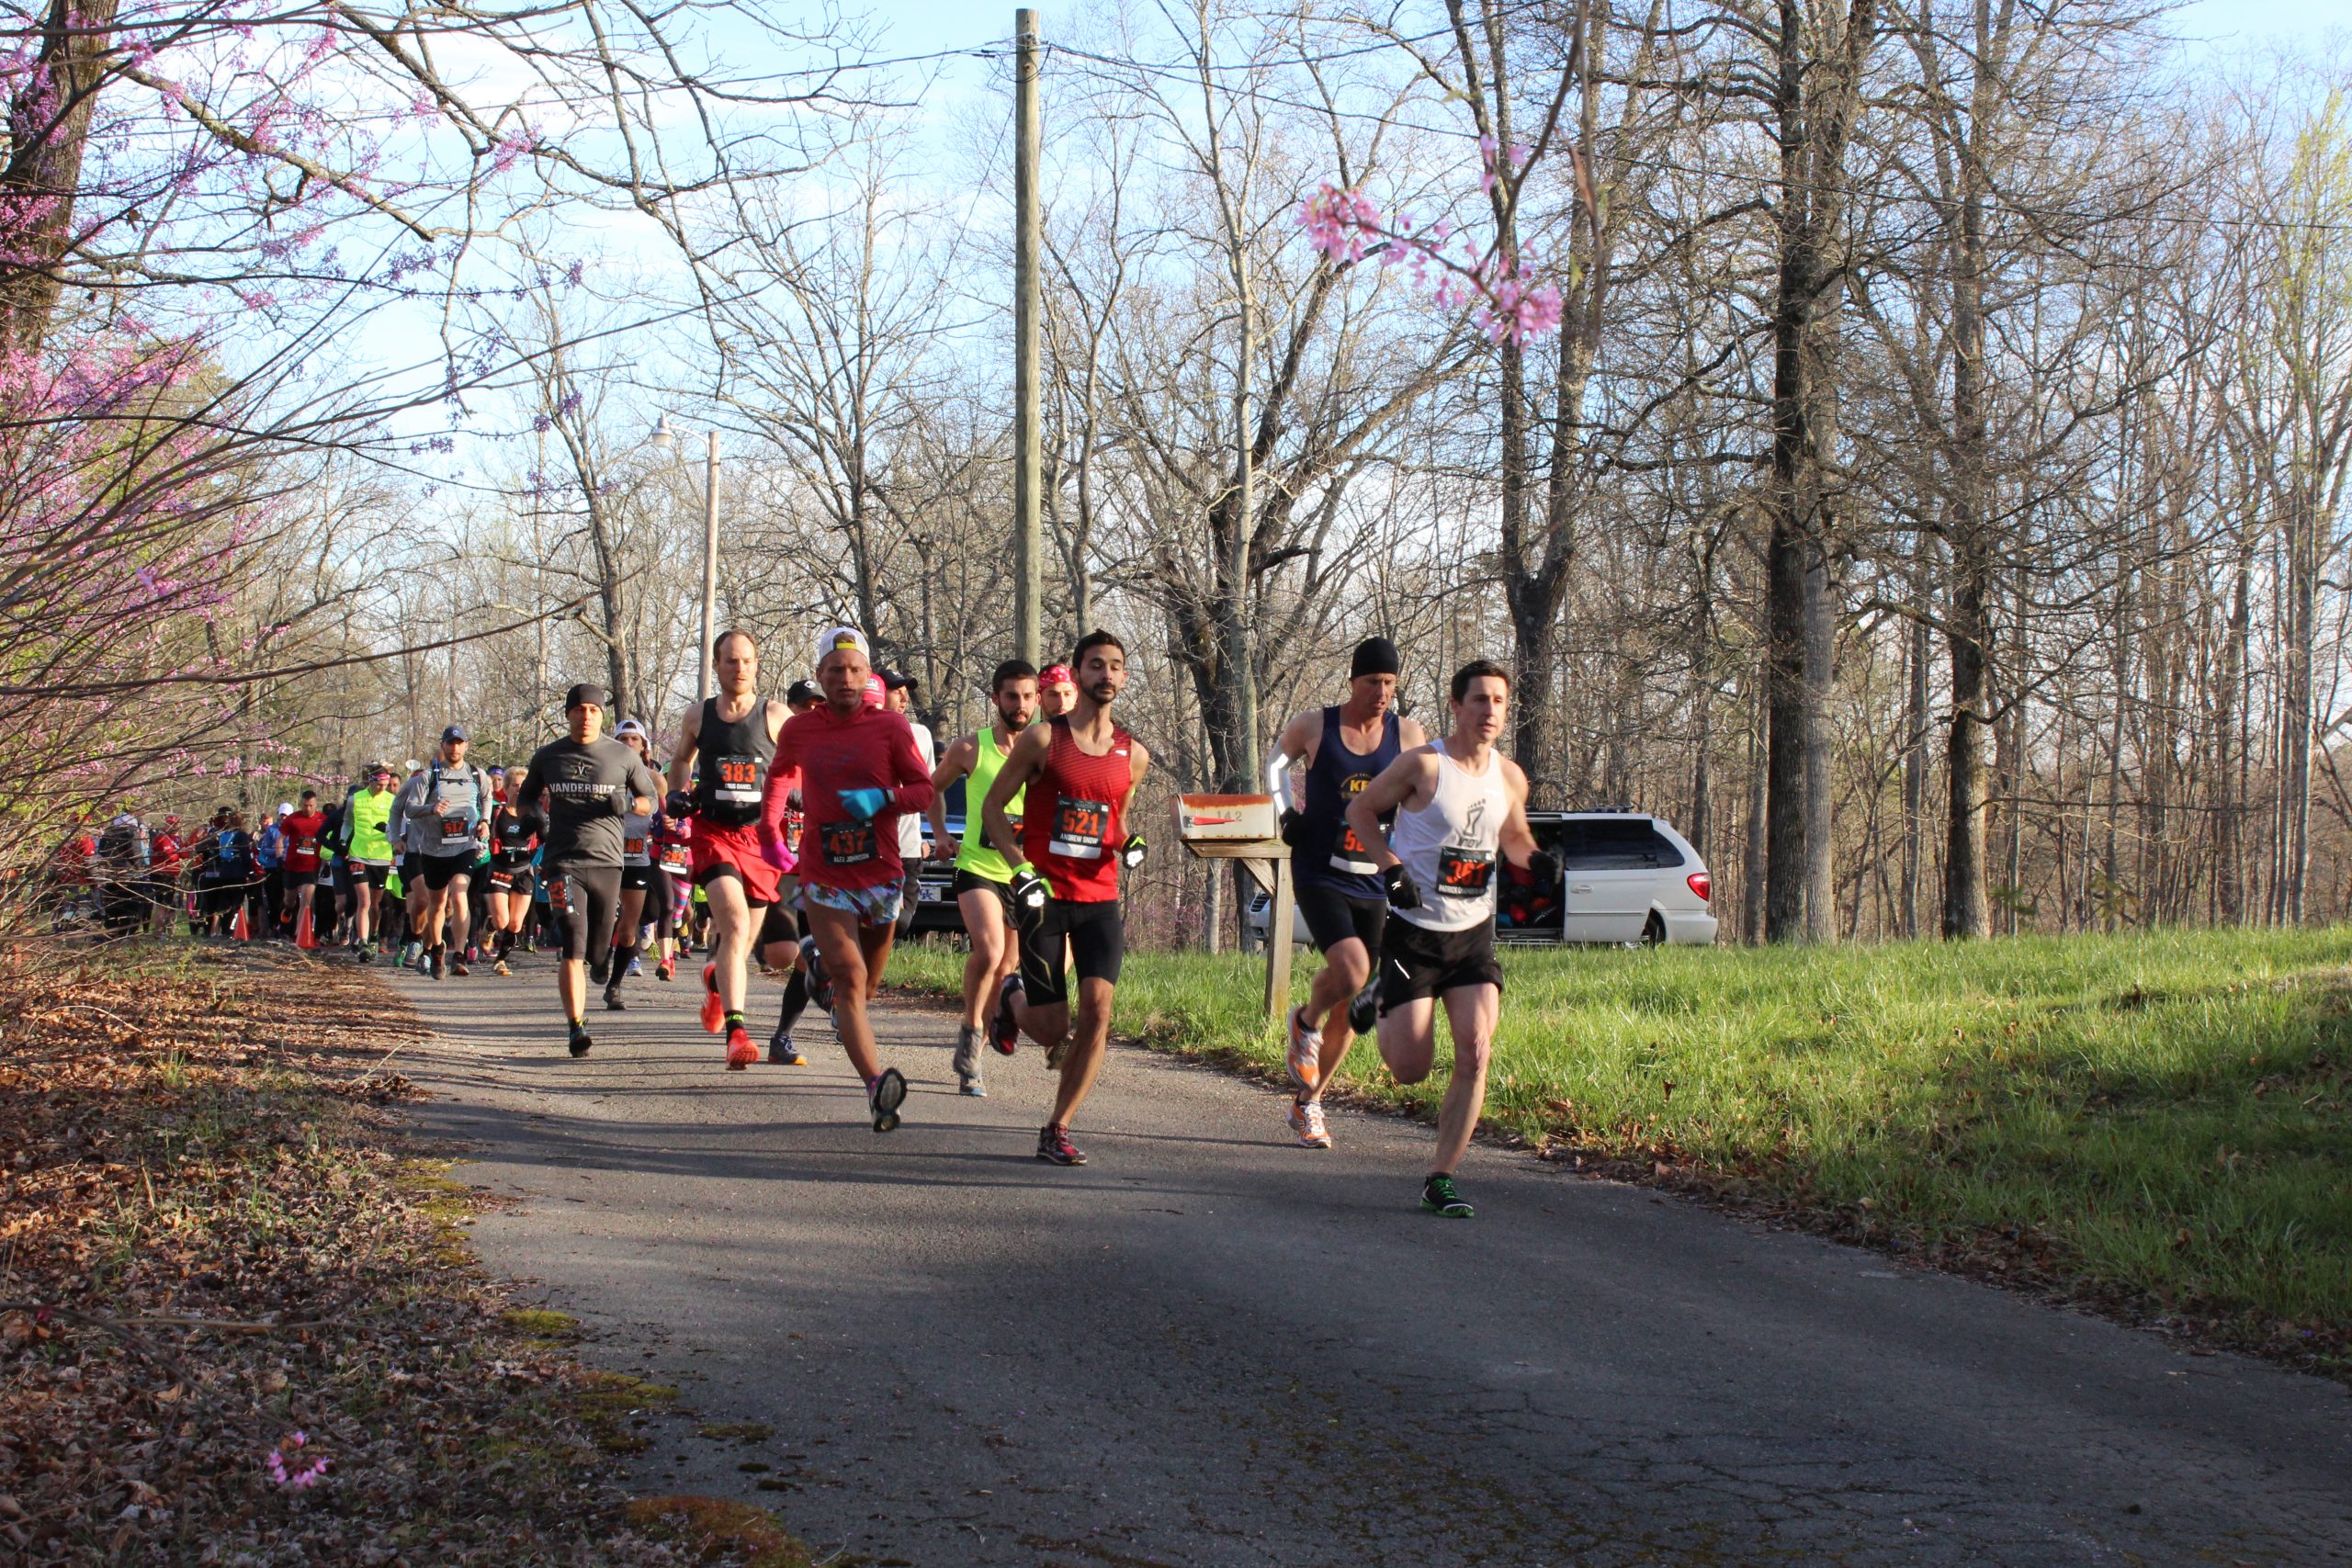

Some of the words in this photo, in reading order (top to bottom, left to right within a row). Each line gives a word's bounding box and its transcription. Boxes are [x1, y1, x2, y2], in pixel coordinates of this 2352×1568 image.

[721, 763, 756, 783] 383
[549, 783, 616, 794] VANDERBILT
[1061, 809, 1099, 836] 521
[830, 830, 868, 854] 437
[1059, 832, 1082, 843] ANDREW
[1082, 835, 1099, 844] SNOW
[846, 852, 869, 863] JOHNSON
[1445, 860, 1486, 886] 361
